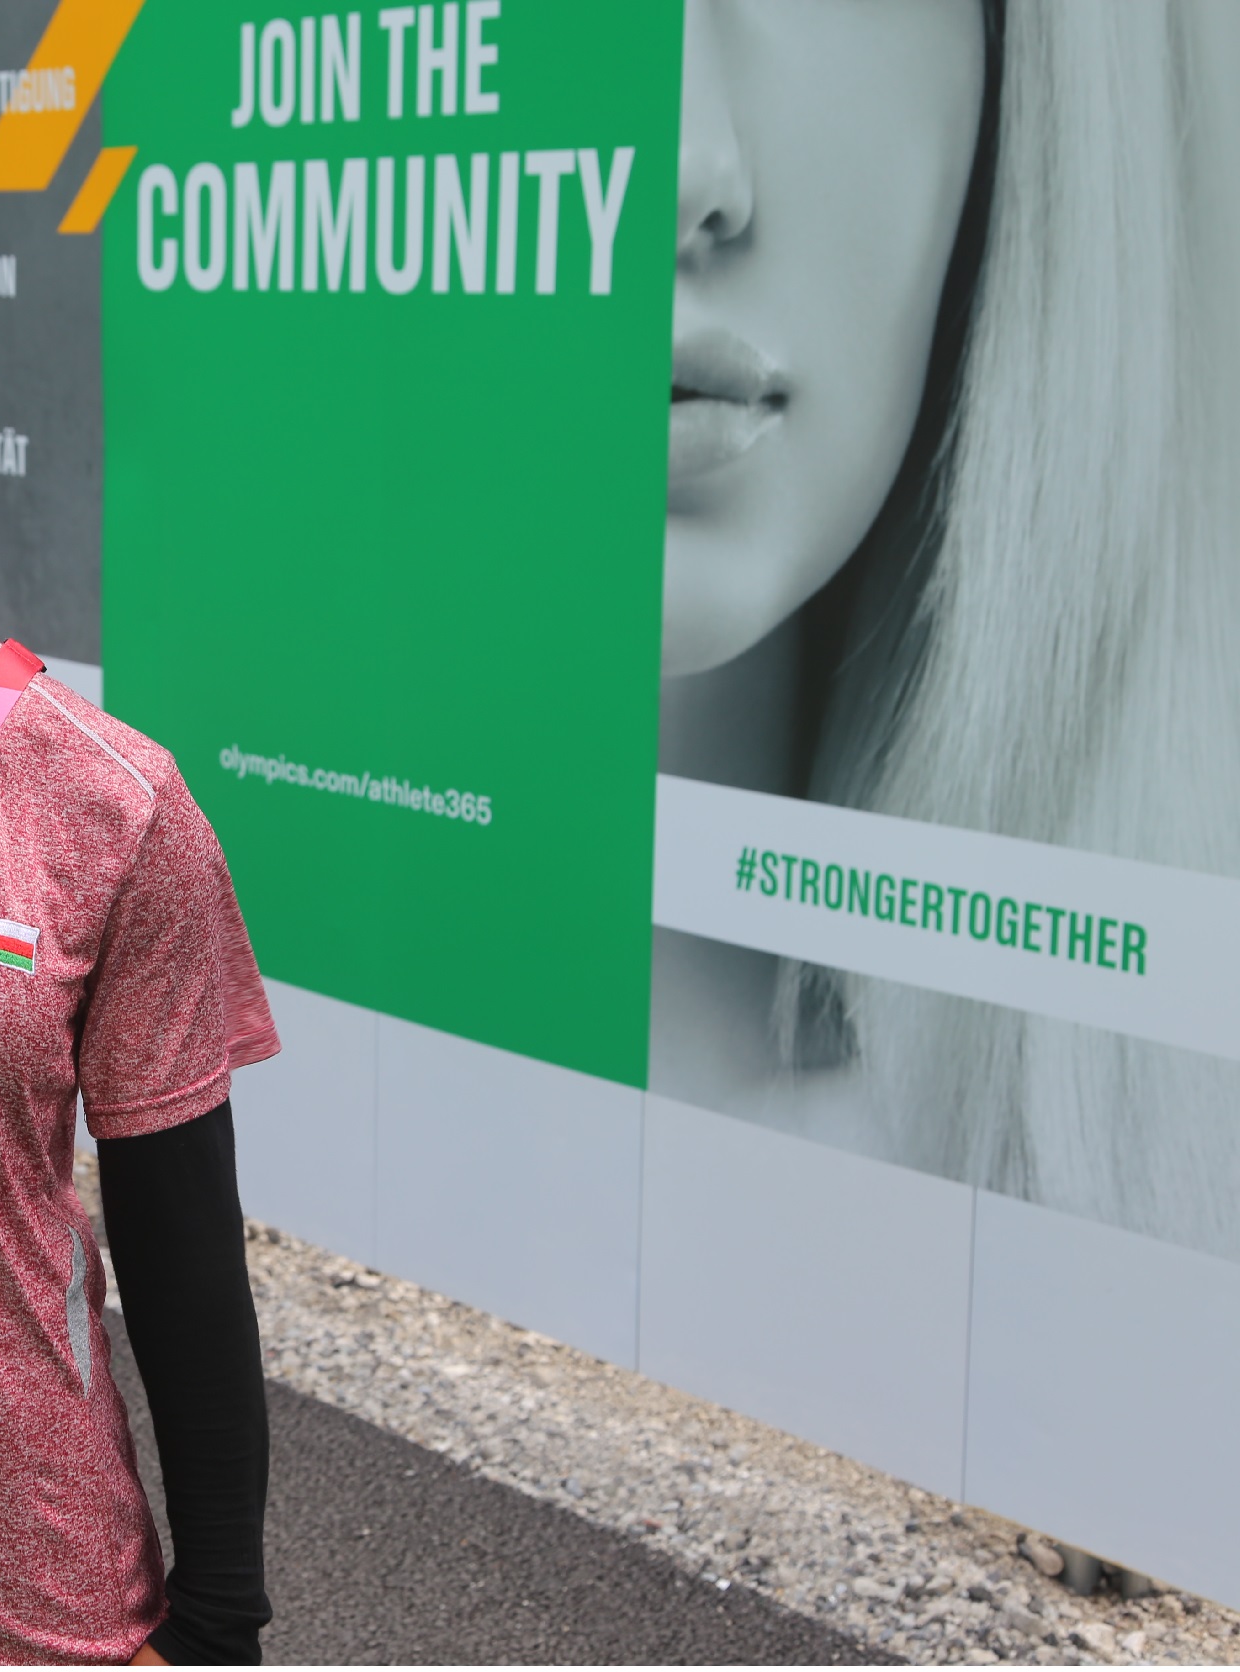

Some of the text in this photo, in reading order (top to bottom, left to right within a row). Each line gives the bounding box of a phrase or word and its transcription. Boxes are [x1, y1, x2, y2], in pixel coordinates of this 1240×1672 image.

[231, 0, 502, 128] JOIN THE
[136, 146, 636, 296] COMMUNITY
[219, 743, 493, 826] olympics.com/athlete365
[735, 846, 1148, 976] #STRONGERTOGETHER
